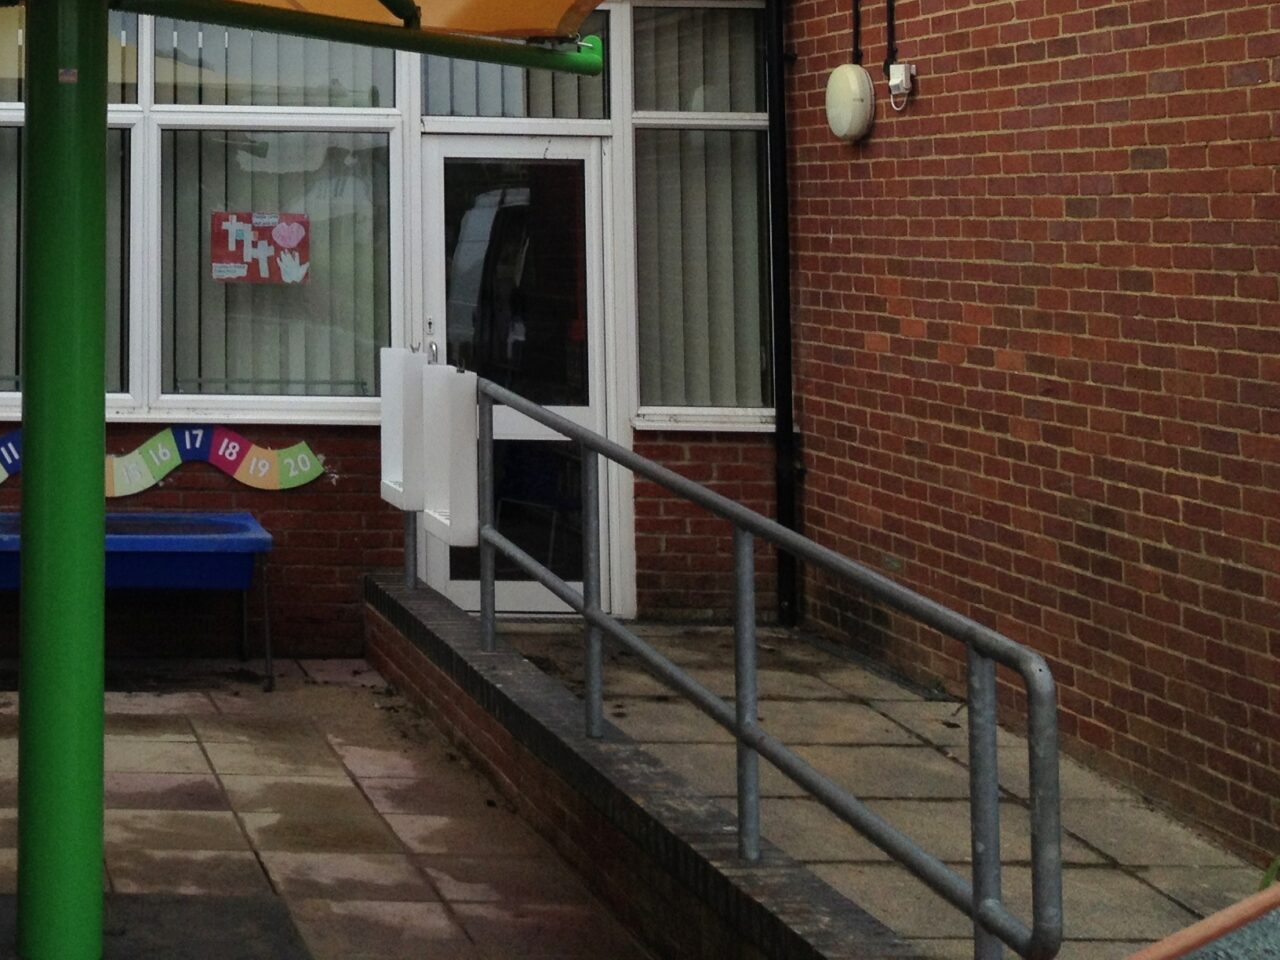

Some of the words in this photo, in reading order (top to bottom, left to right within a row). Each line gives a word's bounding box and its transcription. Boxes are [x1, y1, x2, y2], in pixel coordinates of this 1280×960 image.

[0, 442, 20, 464] 11
[149, 443, 171, 466] 16
[184, 429, 204, 449] 17
[218, 438, 240, 461] 18
[249, 457, 270, 477] 19
[283, 454, 311, 477] 20
